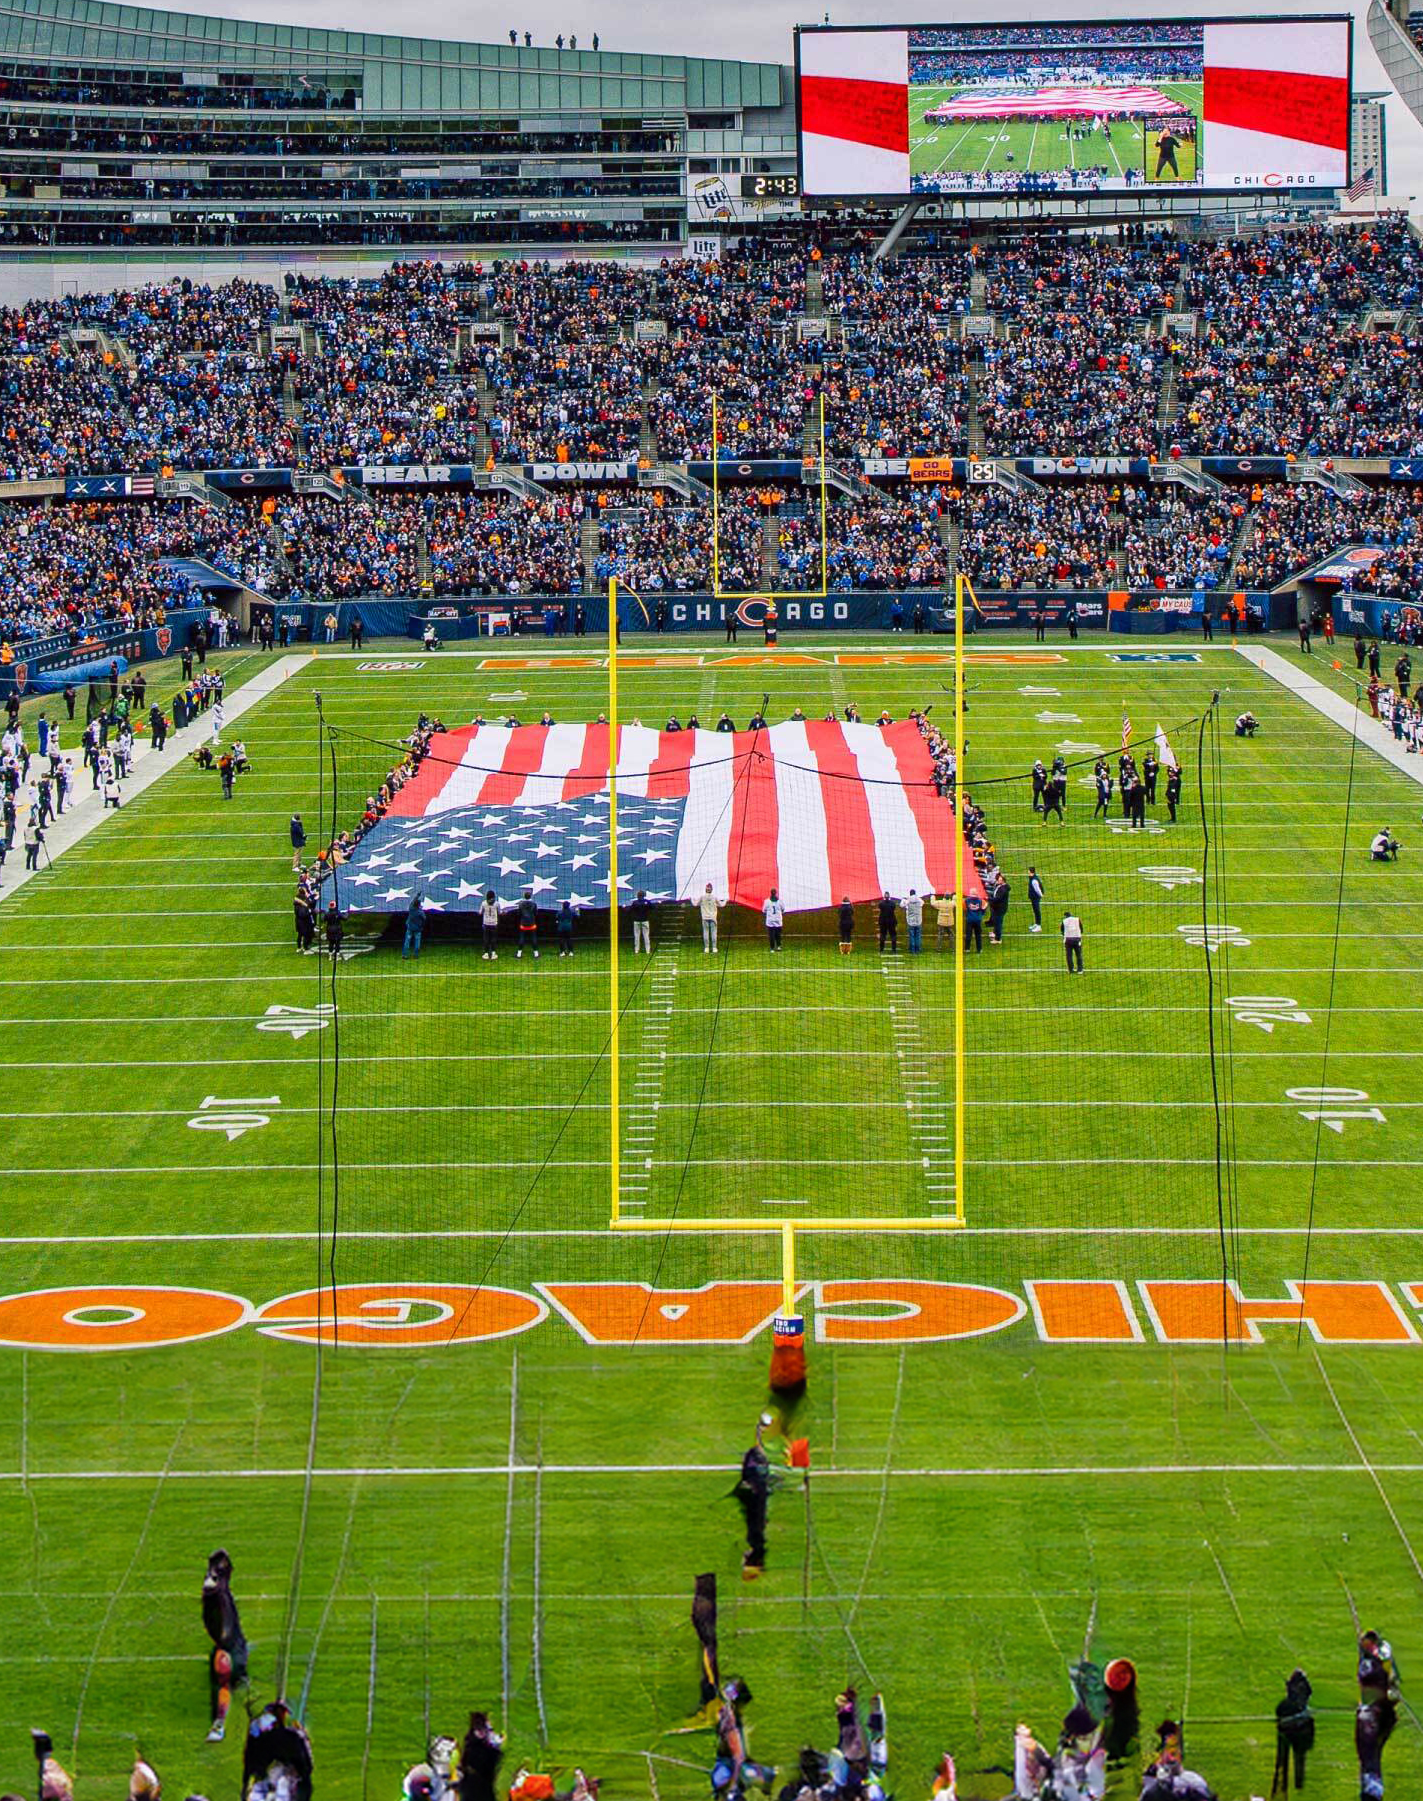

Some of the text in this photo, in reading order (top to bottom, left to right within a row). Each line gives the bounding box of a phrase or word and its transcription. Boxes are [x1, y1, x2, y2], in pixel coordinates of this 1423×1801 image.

[755, 178, 797, 195] 2:43
[1234, 174, 1315, 186] CHICAGO
[694, 241, 715, 255] Lite
[533, 464, 628, 480] DOWN
[865, 461, 911, 475] BE
[923, 461, 939, 469] GO
[362, 467, 451, 482] BEAR
[913, 470, 949, 479] BEARS
[973, 466, 992, 480] 25
[1076, 602, 1102, 610] Bears
[1174, 600, 1193, 608] CAUS
[673, 597, 849, 627] CHICAGO
[475, 653, 1068, 669] BEARS
[1177, 924, 1252, 946] 30
[255, 1003, 339, 1031] 20
[1224, 996, 1313, 1024] 20
[1285, 1086, 1387, 1123] 10
[186, 1095, 282, 1131] 10
